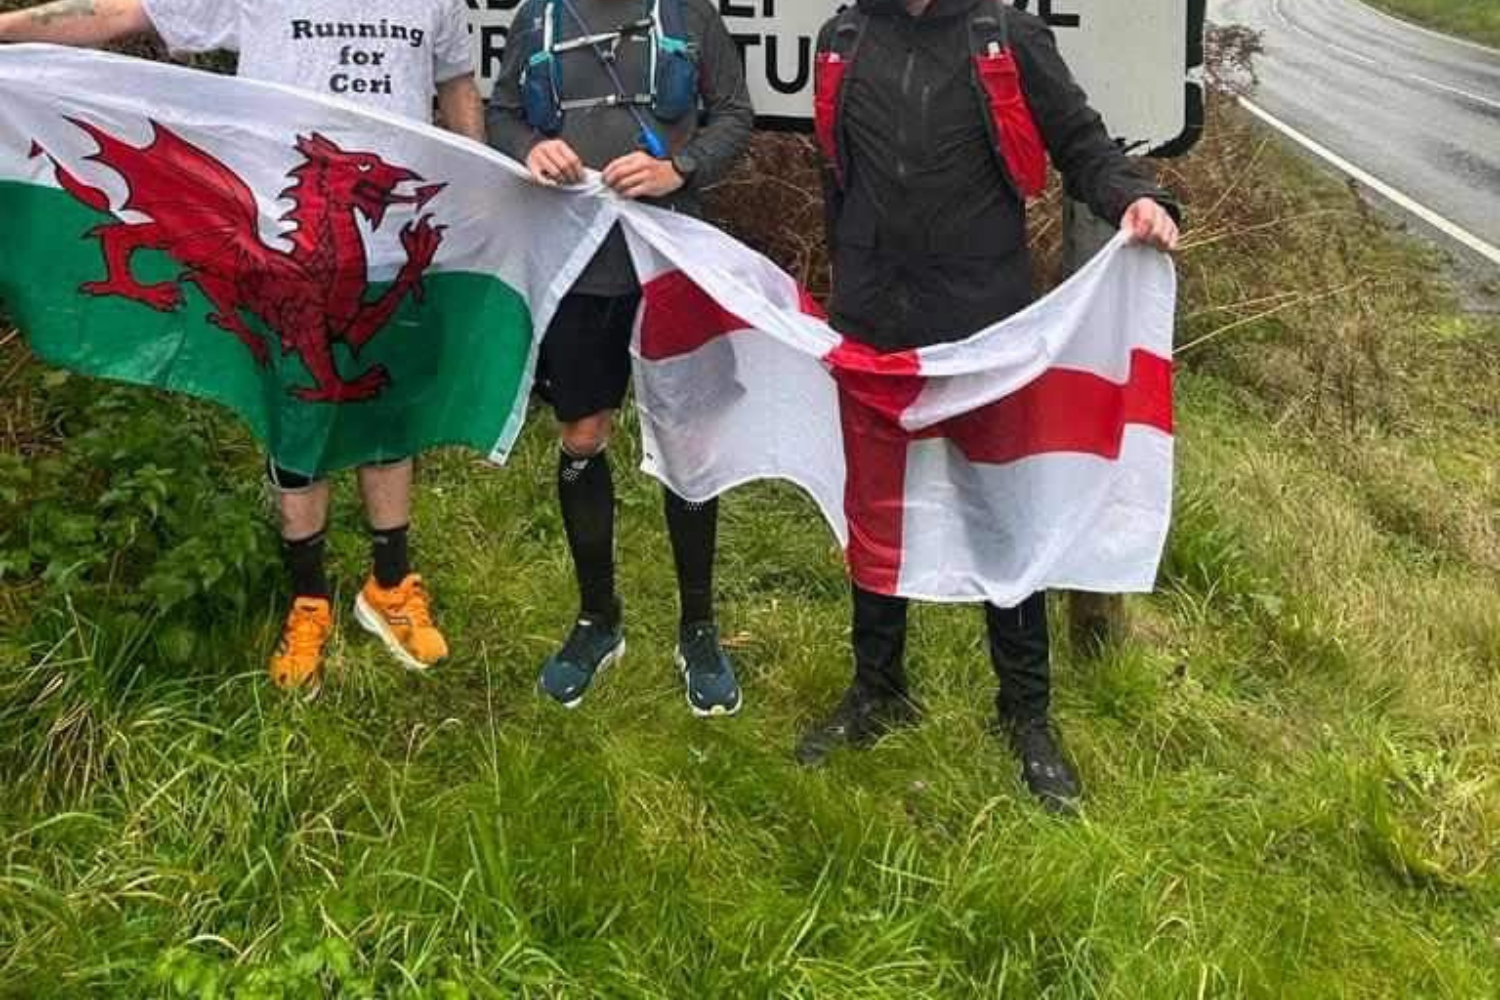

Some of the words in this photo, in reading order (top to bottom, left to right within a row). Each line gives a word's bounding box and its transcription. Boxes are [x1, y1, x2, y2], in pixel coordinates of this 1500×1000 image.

[291, 19, 425, 47] Running
[338, 45, 385, 66] for
[329, 74, 392, 94] Ceri
